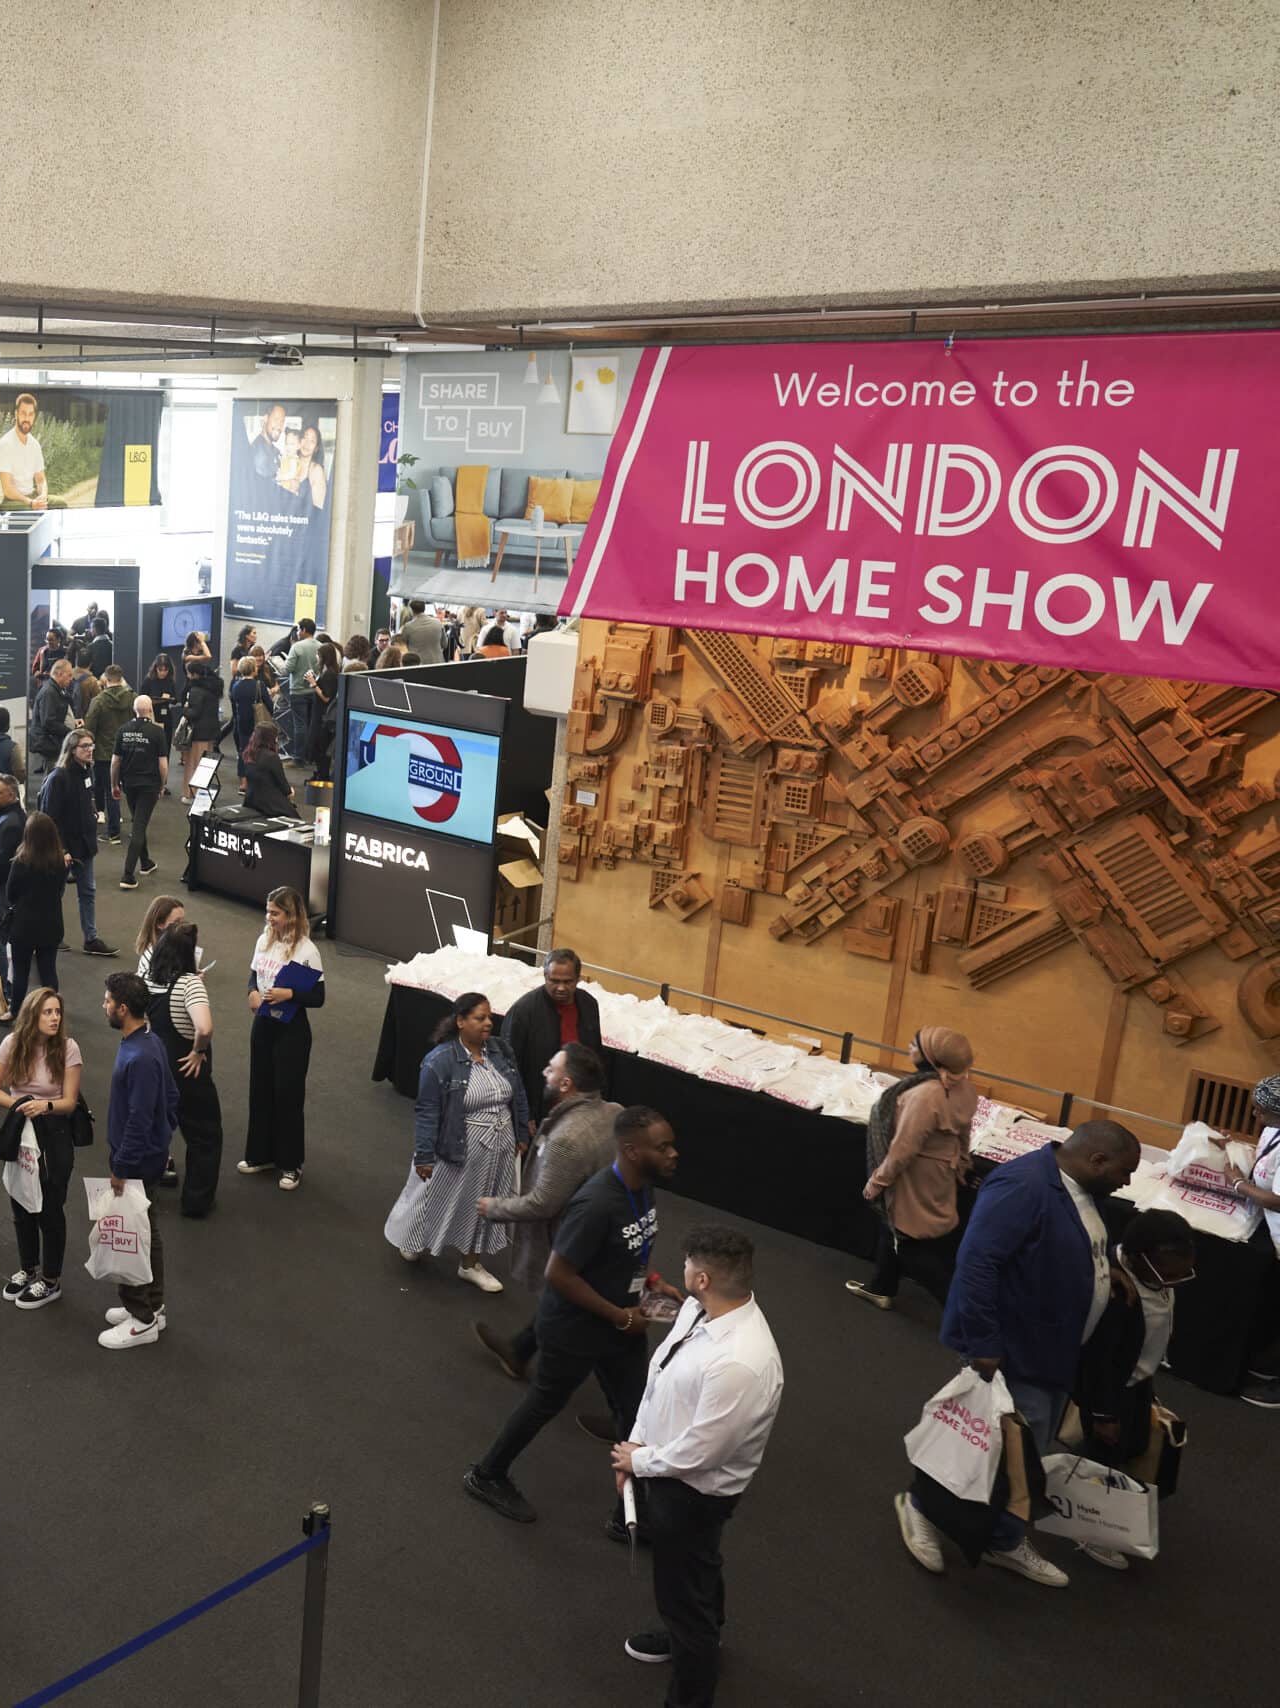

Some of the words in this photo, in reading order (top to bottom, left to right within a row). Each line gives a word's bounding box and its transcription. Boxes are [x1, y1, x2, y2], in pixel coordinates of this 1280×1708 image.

[429, 383, 488, 400] SHARE
[773, 364, 976, 408] Welcome
[992, 370, 1038, 408] to
[1056, 360, 1135, 408] the
[435, 415, 458, 431] TO
[477, 421, 513, 438] BUY
[129, 450, 147, 464] L&Q
[680, 439, 1240, 552] LONDON
[673, 547, 897, 620] HOME
[918, 563, 1215, 647] SHOW
[345, 832, 430, 872] FABRICA
[1188, 1167, 1222, 1182] SHARE
[102, 1218, 119, 1228] ARE
[114, 1238, 134, 1247] BUY
[1077, 1503, 1101, 1516] Hyde
